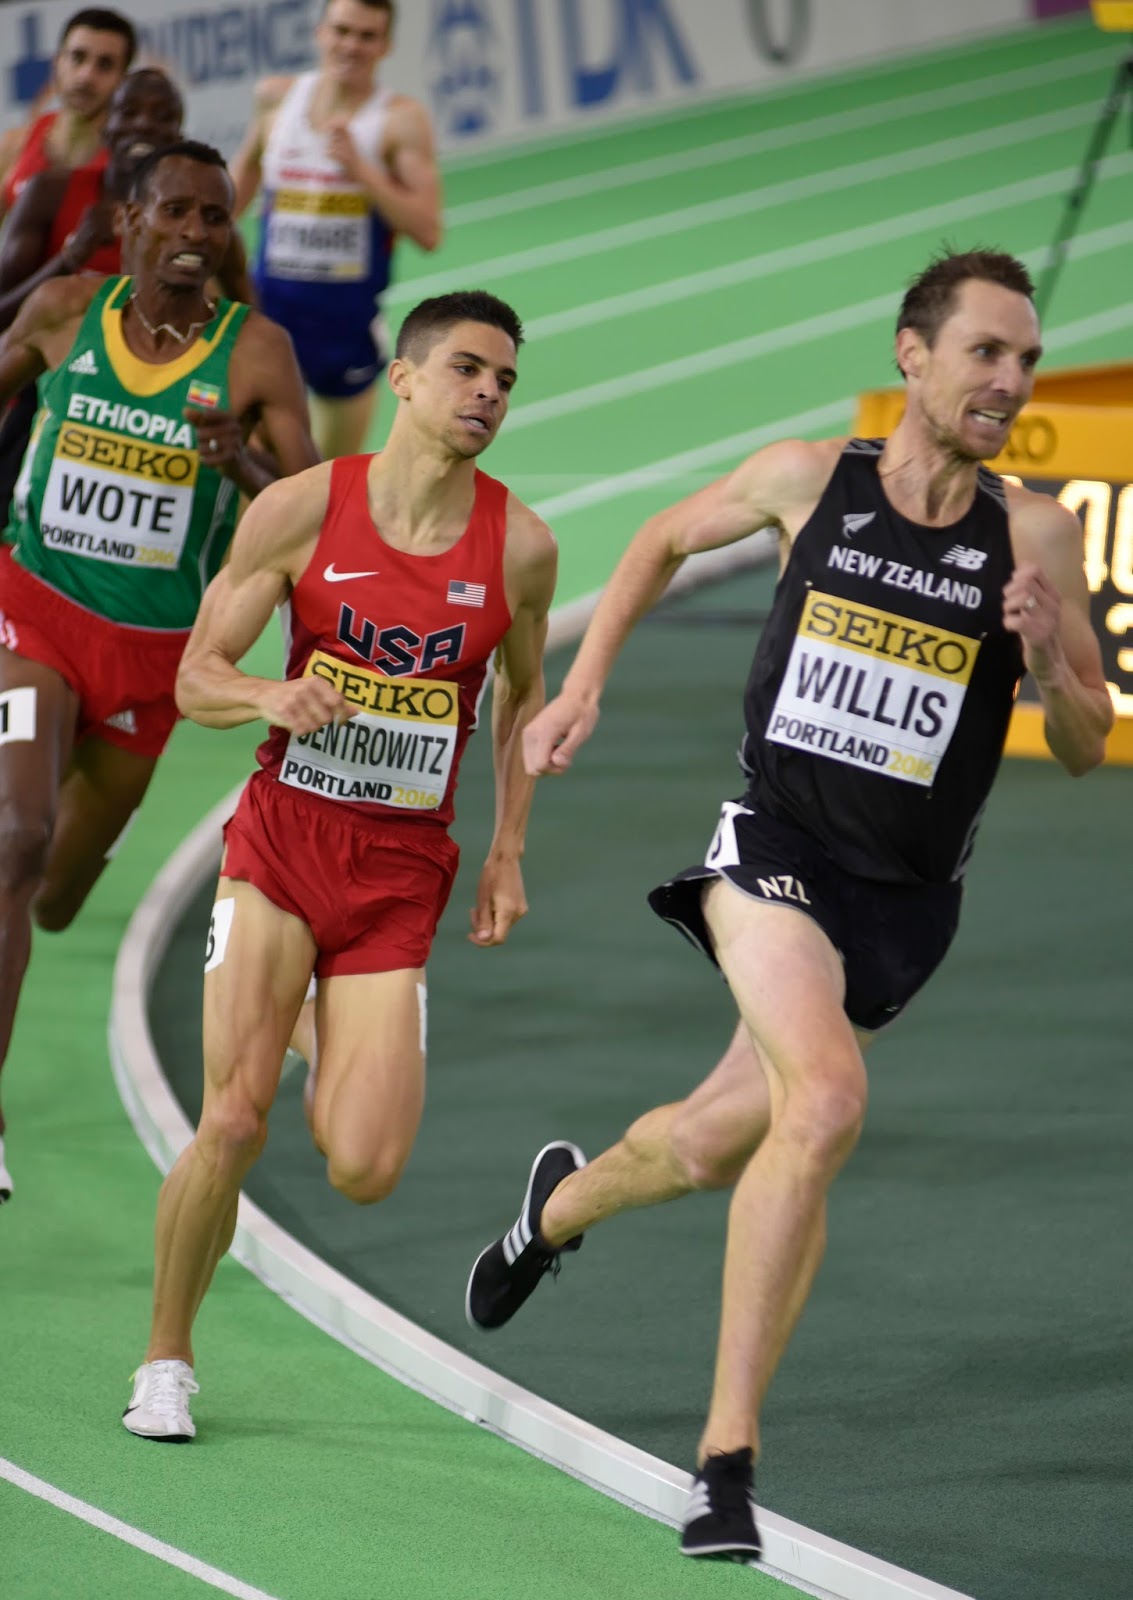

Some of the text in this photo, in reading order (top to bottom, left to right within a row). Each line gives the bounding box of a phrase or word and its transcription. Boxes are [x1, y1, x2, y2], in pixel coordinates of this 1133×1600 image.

[67, 393, 192, 448] ETHIOPIA
[61, 429, 192, 481] SEIKO
[60, 474, 176, 533] WOTE
[41, 524, 135, 560] PORTLAND
[827, 545, 982, 610] NEW ZEALAND
[337, 601, 466, 678] USA
[806, 602, 968, 674] SEIKO
[311, 661, 453, 719] SEIKO
[796, 652, 948, 738] WILLIS
[771, 715, 934, 781] PORTLAND 2016
[283, 760, 439, 807] PORTLAND 2016
[757, 875, 811, 904] NZL
